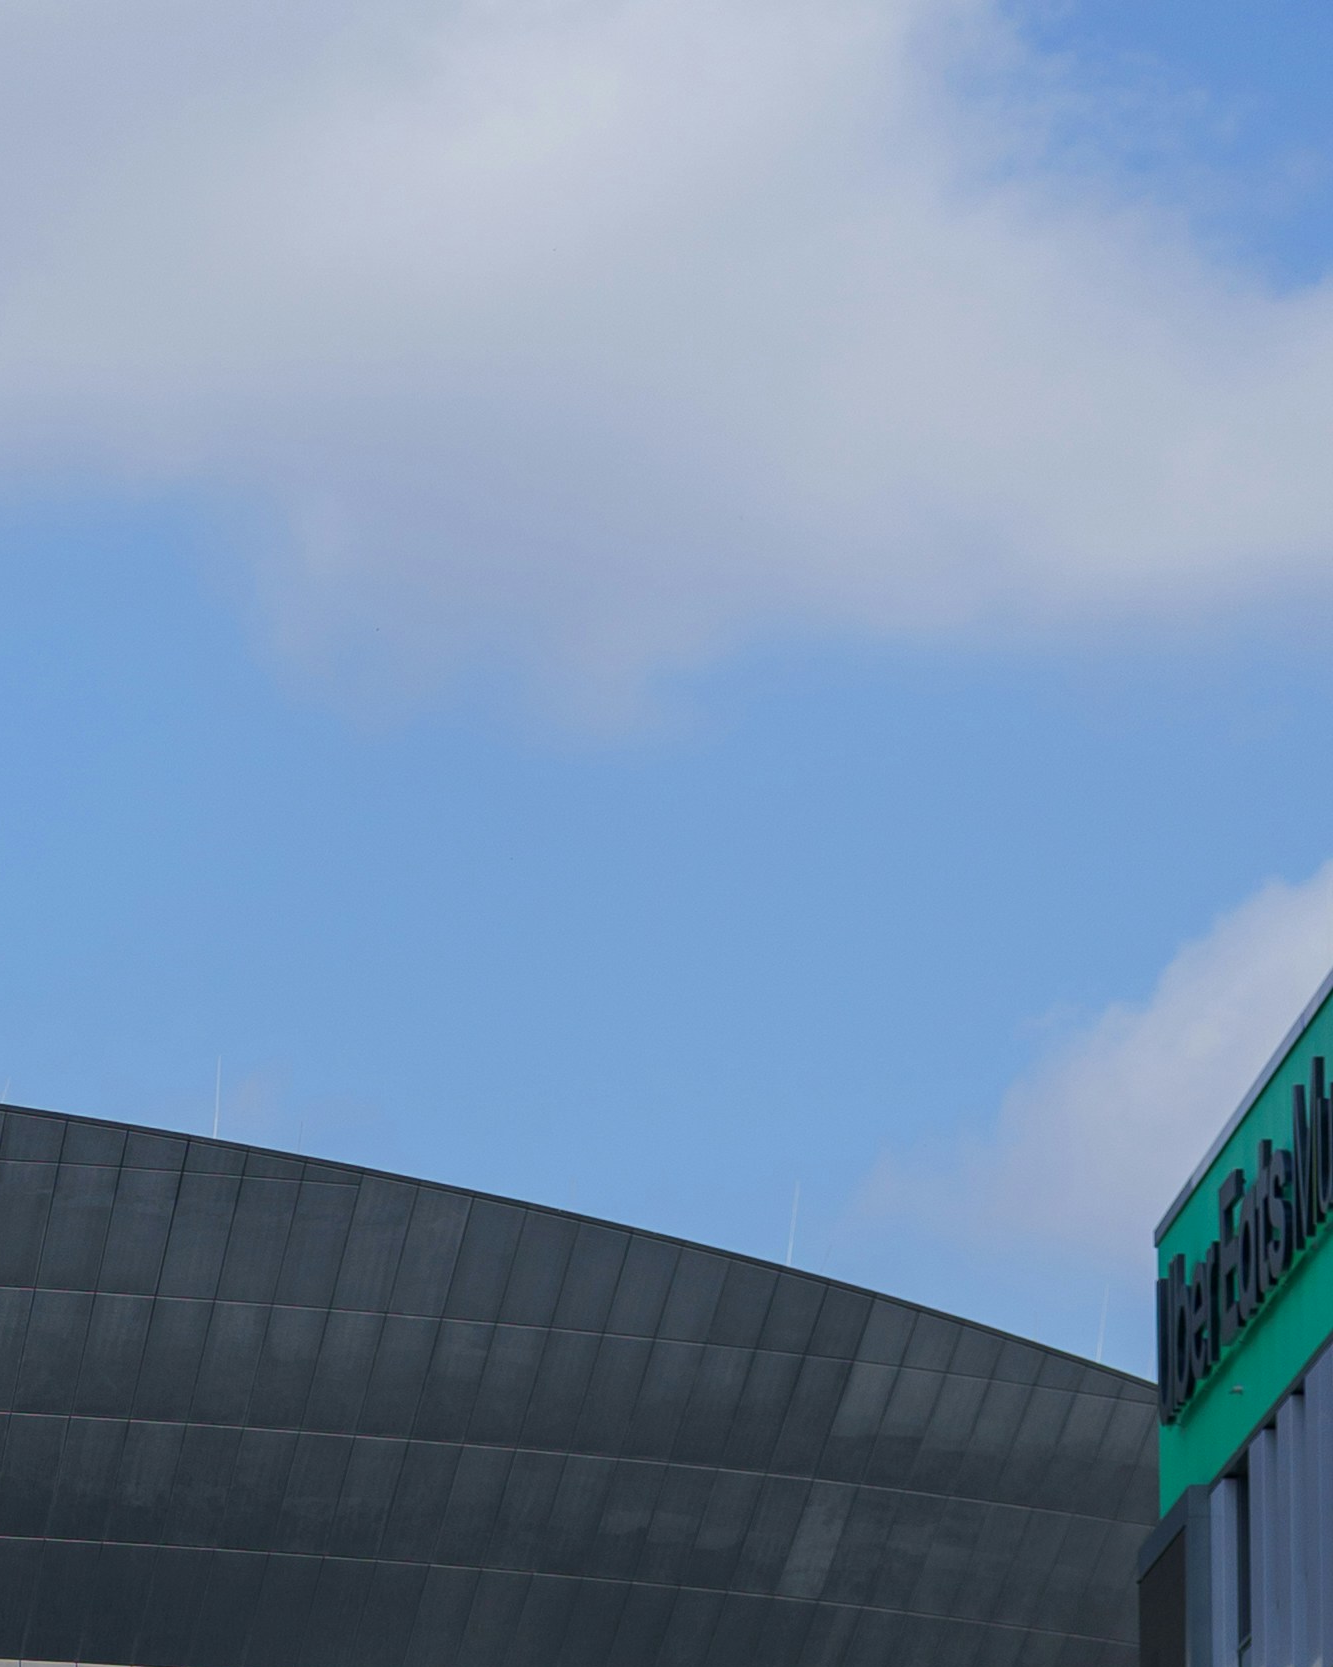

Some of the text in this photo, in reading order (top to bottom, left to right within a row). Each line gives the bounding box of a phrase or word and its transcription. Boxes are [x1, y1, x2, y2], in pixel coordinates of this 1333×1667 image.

[1156, 1056, 1333, 1426] Uber Eats Mu
